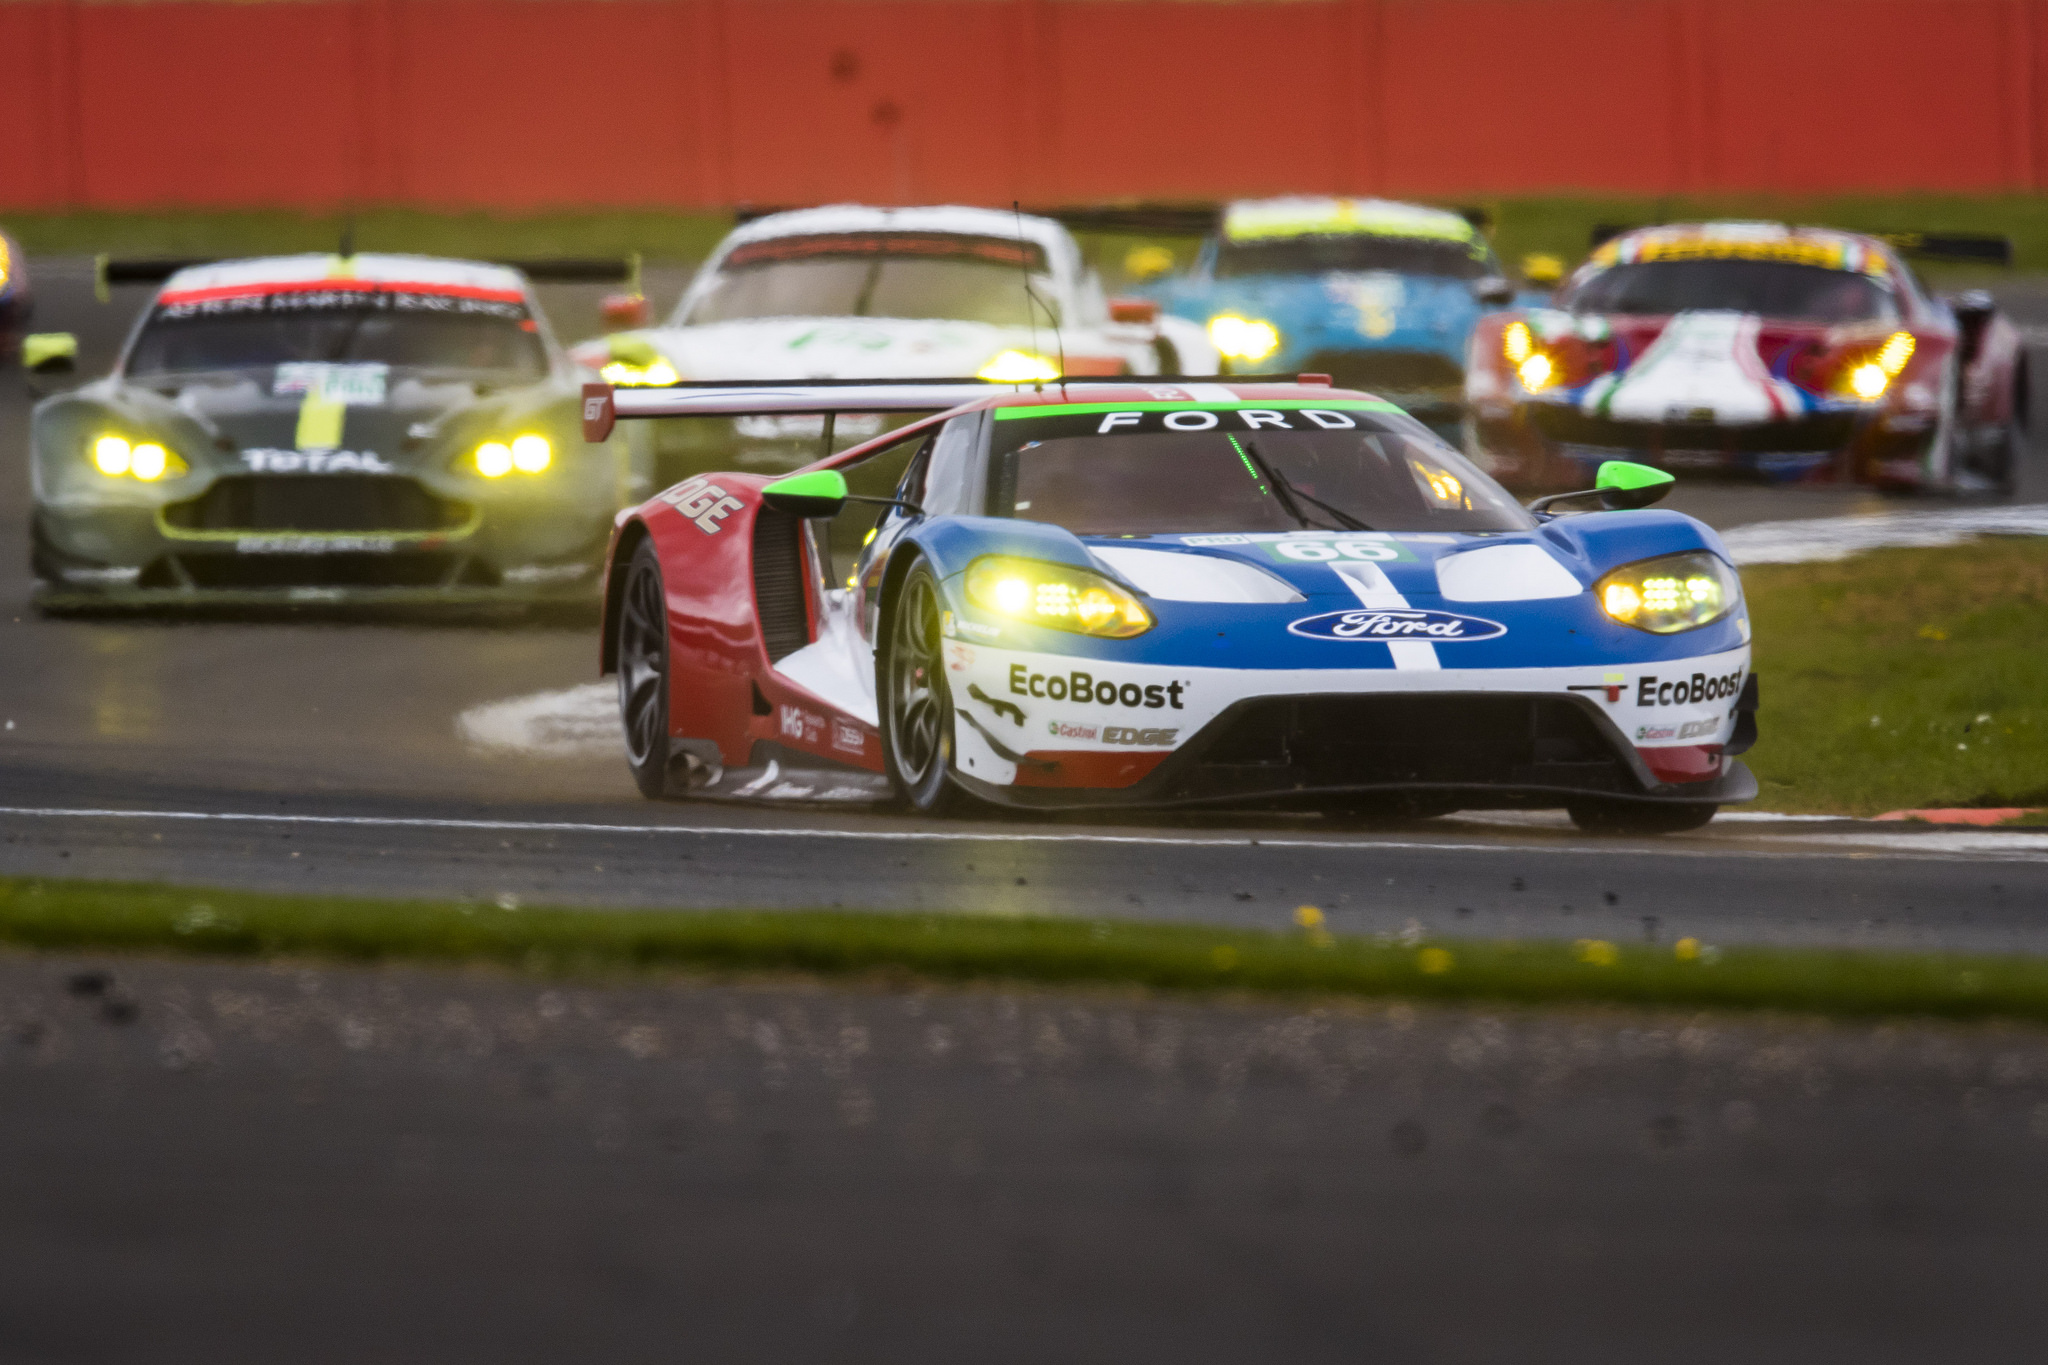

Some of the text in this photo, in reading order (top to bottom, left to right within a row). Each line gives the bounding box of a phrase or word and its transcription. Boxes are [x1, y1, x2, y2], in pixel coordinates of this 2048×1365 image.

[584, 397, 608, 421] GT
[1098, 409, 1356, 433] FORD
[240, 448, 393, 473] TOTAL
[658, 477, 745, 535] DGE
[1188, 536, 1242, 546] PRO
[1276, 541, 1399, 561] 66
[1332, 612, 1465, 637] Ford
[1009, 663, 1185, 710] EcoBoost
[1637, 670, 1743, 707] EcoBoost
[1059, 723, 1181, 746] Castrol EDGE
